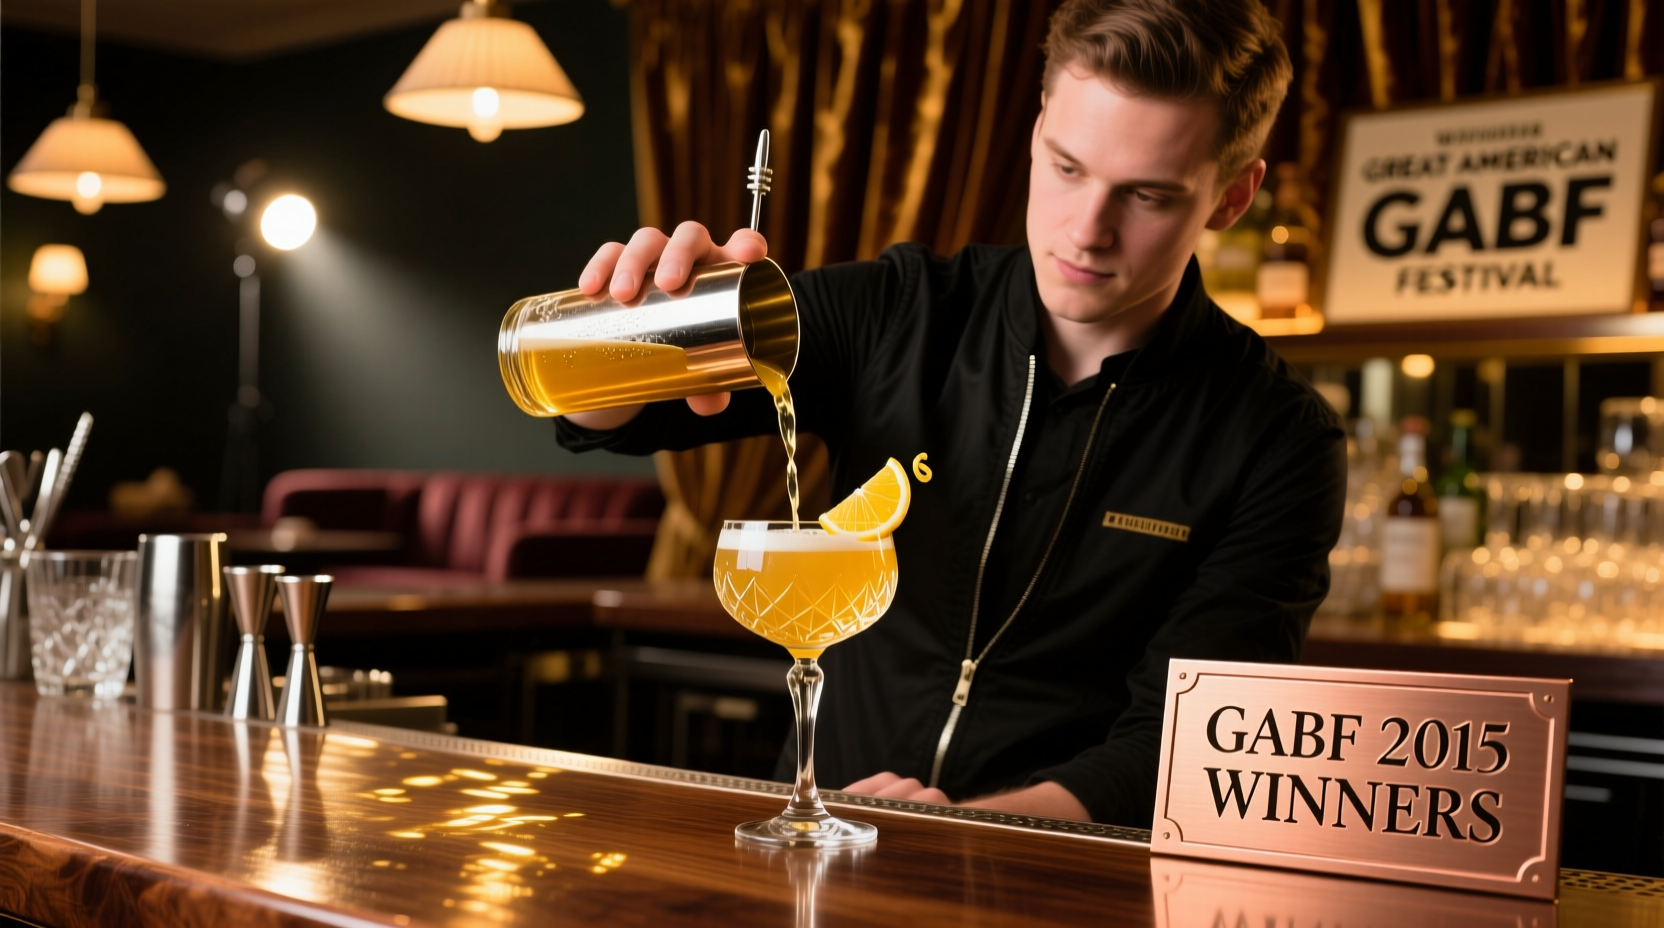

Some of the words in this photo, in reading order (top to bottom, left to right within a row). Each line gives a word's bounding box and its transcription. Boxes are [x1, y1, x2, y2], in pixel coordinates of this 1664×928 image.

[1362, 155, 1448, 182] GREAT
[1457, 138, 1618, 174] AMERICAN
[1362, 175, 1613, 260] GABF
[1396, 261, 1560, 294] FESTIVAL
[1205, 705, 1362, 762] GABF
[1376, 716, 1511, 774] 2015
[1203, 767, 1504, 844] WINNERS
